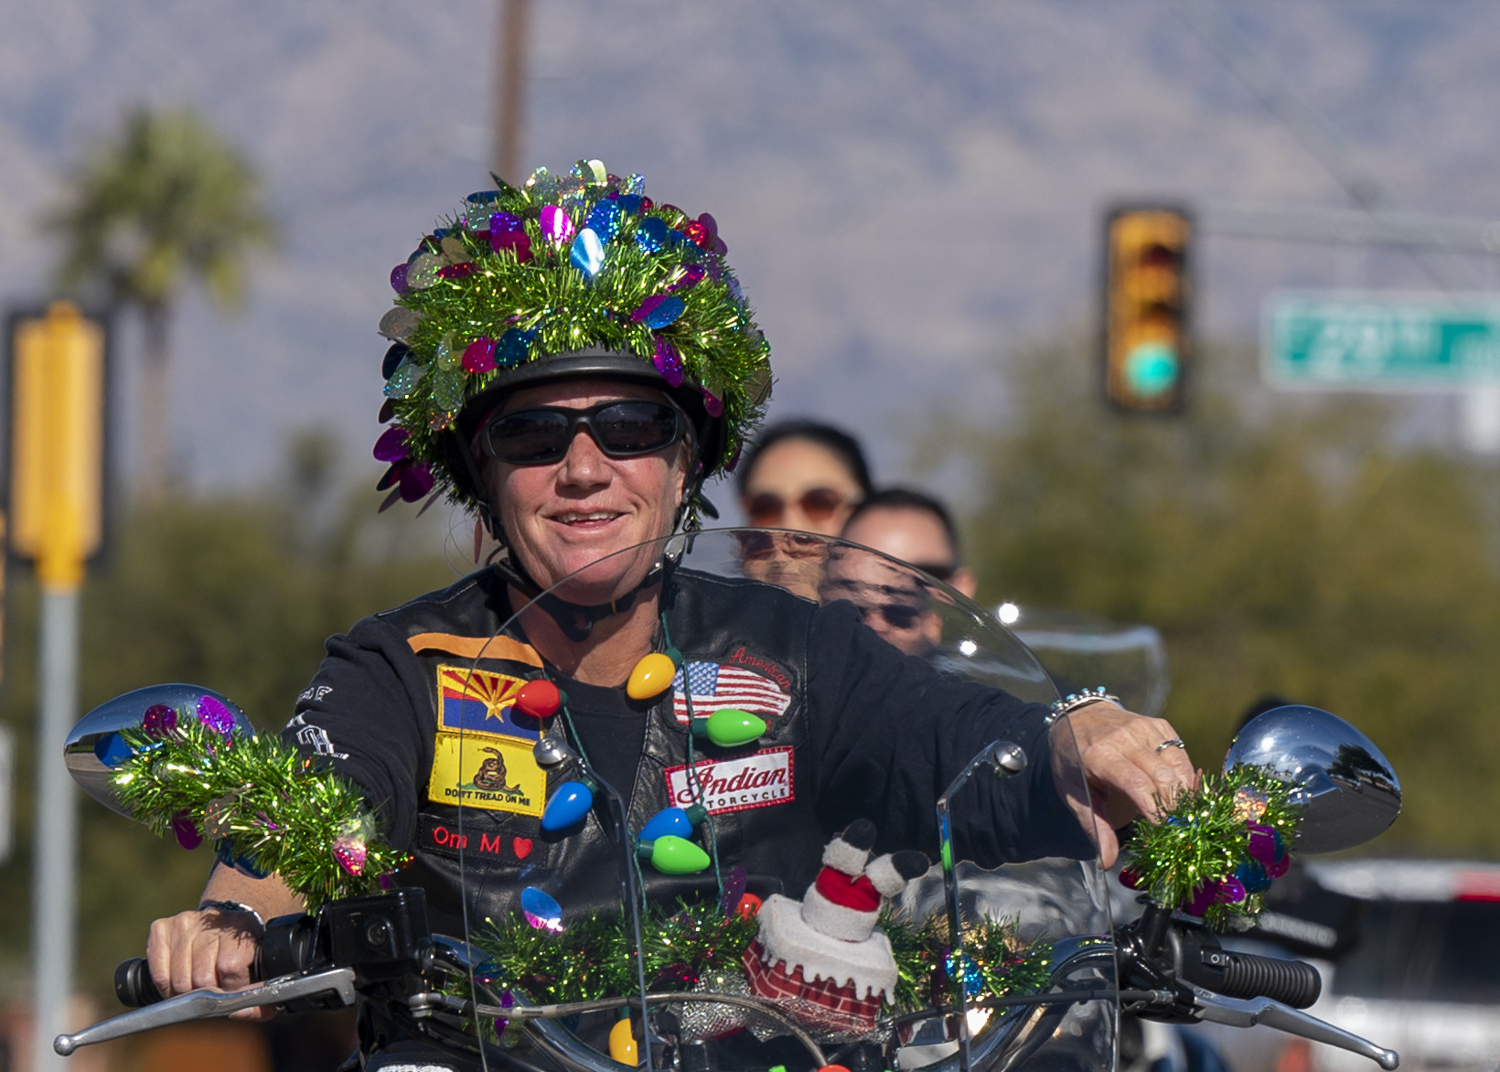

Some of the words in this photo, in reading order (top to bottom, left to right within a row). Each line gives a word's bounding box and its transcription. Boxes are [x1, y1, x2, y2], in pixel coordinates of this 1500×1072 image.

[729, 648, 791, 689] American
[676, 765, 787, 804] Indian
[475, 791, 503, 801] TREAD
[505, 794, 517, 803] ON
[519, 797, 531, 806] ME
[706, 788, 786, 809] TORCYCLE
[434, 827, 467, 849] Om
[480, 834, 501, 854] M
